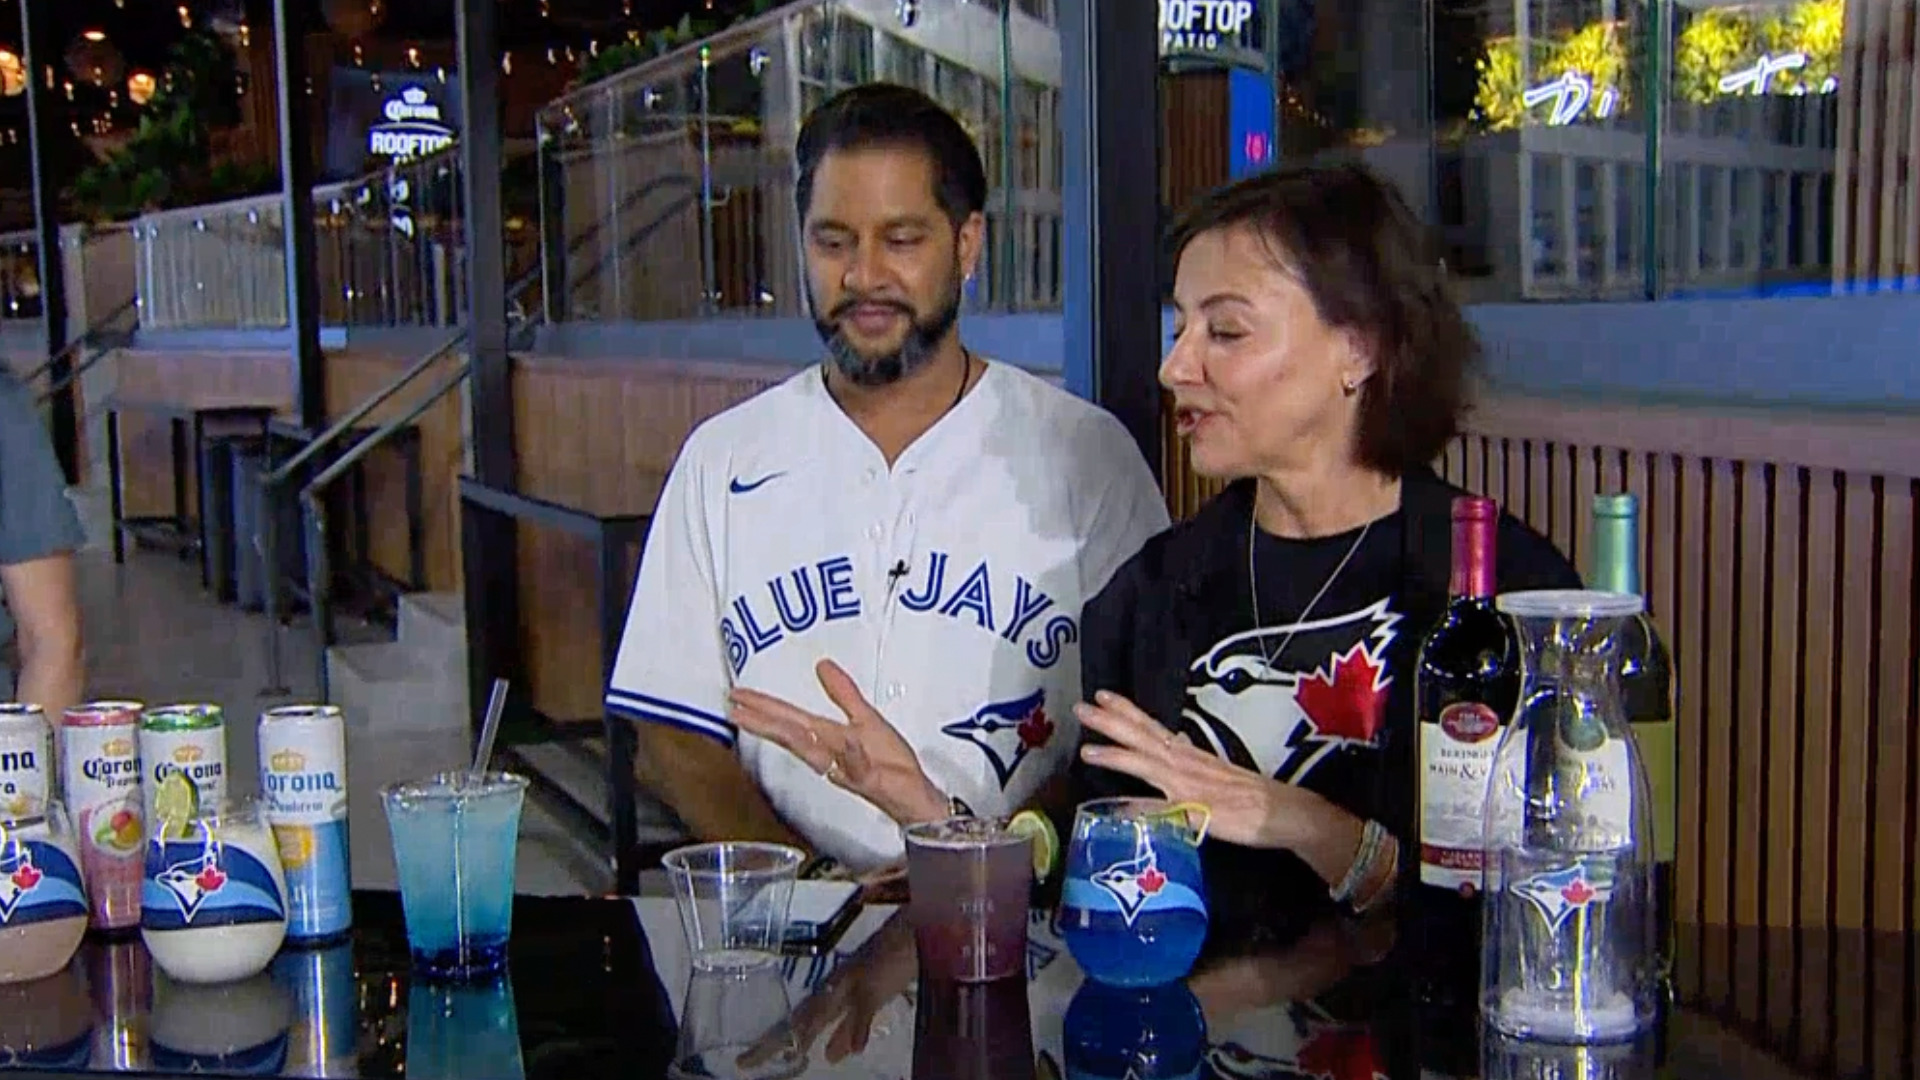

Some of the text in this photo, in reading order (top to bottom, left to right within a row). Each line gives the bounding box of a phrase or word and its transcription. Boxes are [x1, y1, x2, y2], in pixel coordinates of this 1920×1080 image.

[1158, 0, 1252, 33] OFTOP
[1162, 32, 1217, 50] PATIO
[720, 552, 1078, 678] BLUE JAYS
[82, 757, 142, 782] Coron
